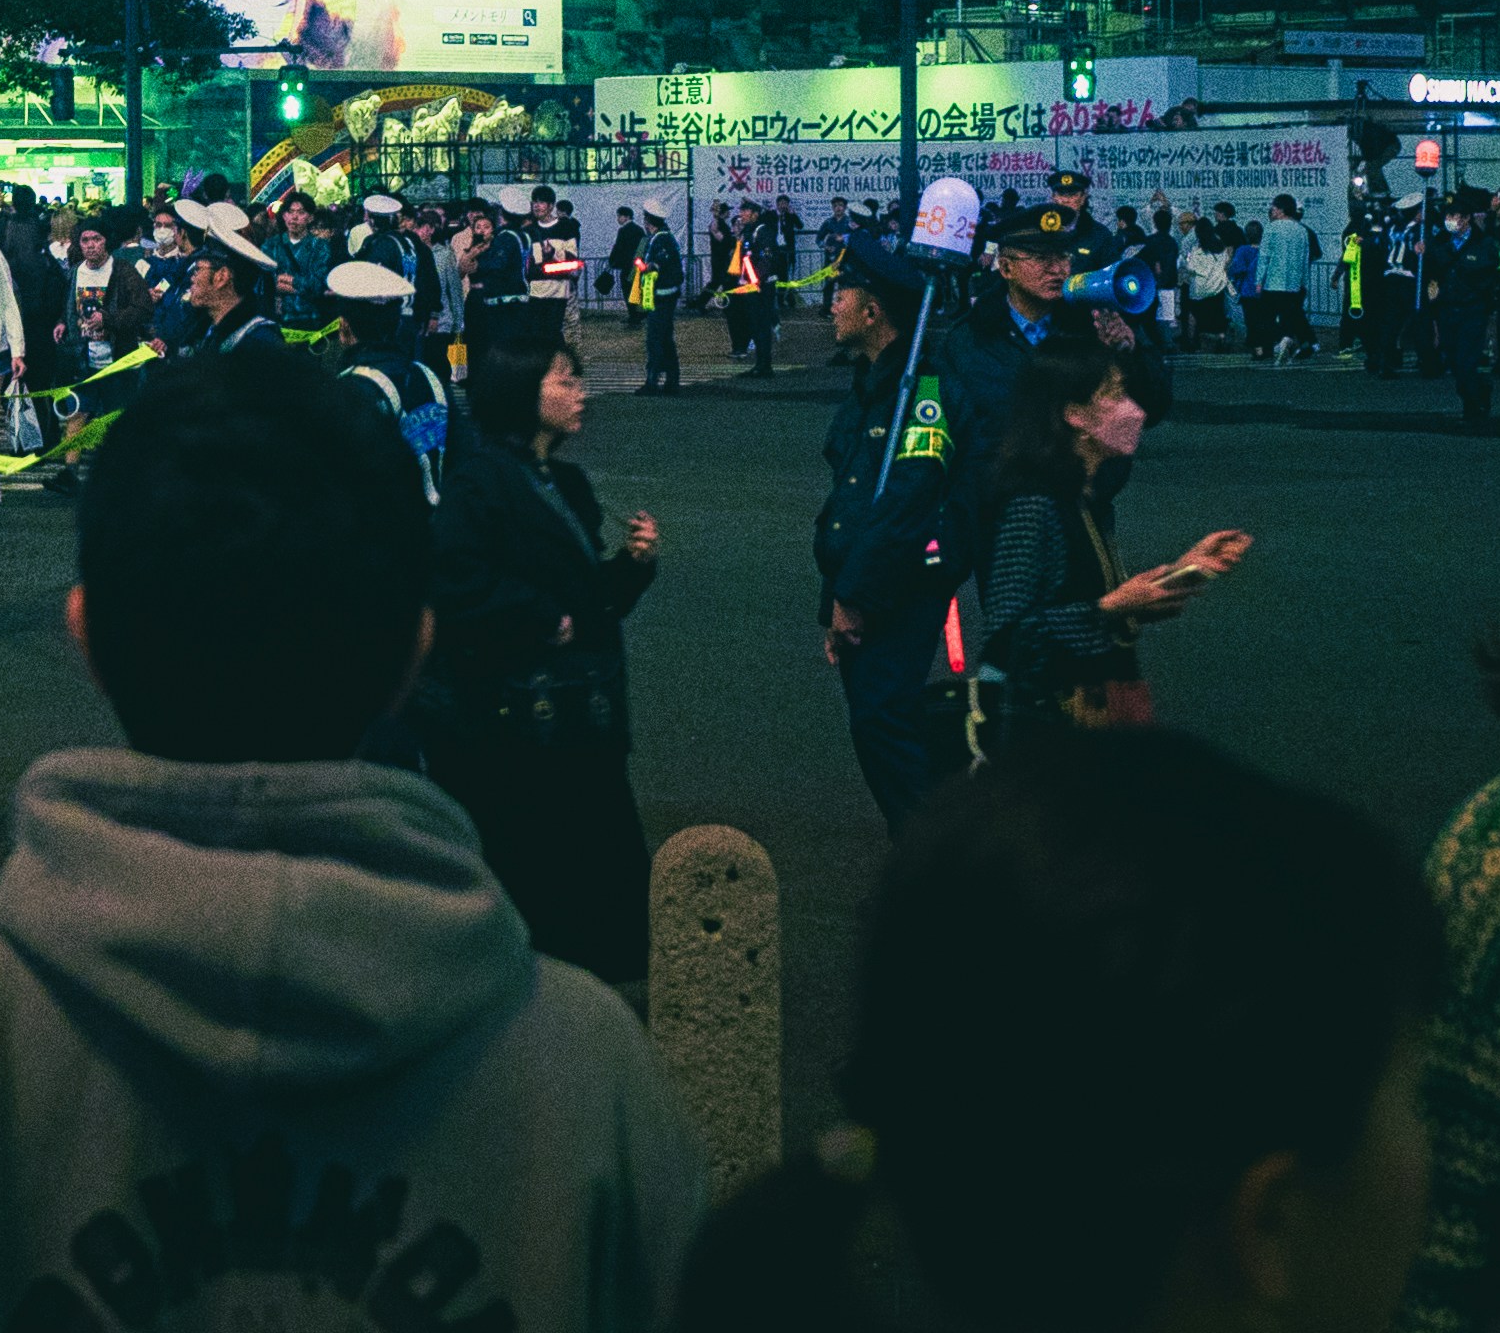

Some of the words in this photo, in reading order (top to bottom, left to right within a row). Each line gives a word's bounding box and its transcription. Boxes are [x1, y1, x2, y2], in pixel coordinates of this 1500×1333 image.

[450, 8, 508, 23] メメントモリ
[655, 75, 713, 106] 【注意】
[656, 102, 1155, 145] 渋谷はハロウィーンイベンの会場ではありません
[756, 150, 1050, 177] 渋谷はハロウィーンイベの会場ではありません。
[756, 179, 774, 194] NO
[777, 178, 824, 194] EVENTS
[828, 177, 850, 193] FOR
[854, 175, 926, 192] HALLOWN
[1111, 169, 1143, 190] EVENTS
[1163, 169, 1219, 189] HALLOWEEN
[1222, 168, 1235, 189] ON
[1236, 167, 1279, 188] SHIBUYA
